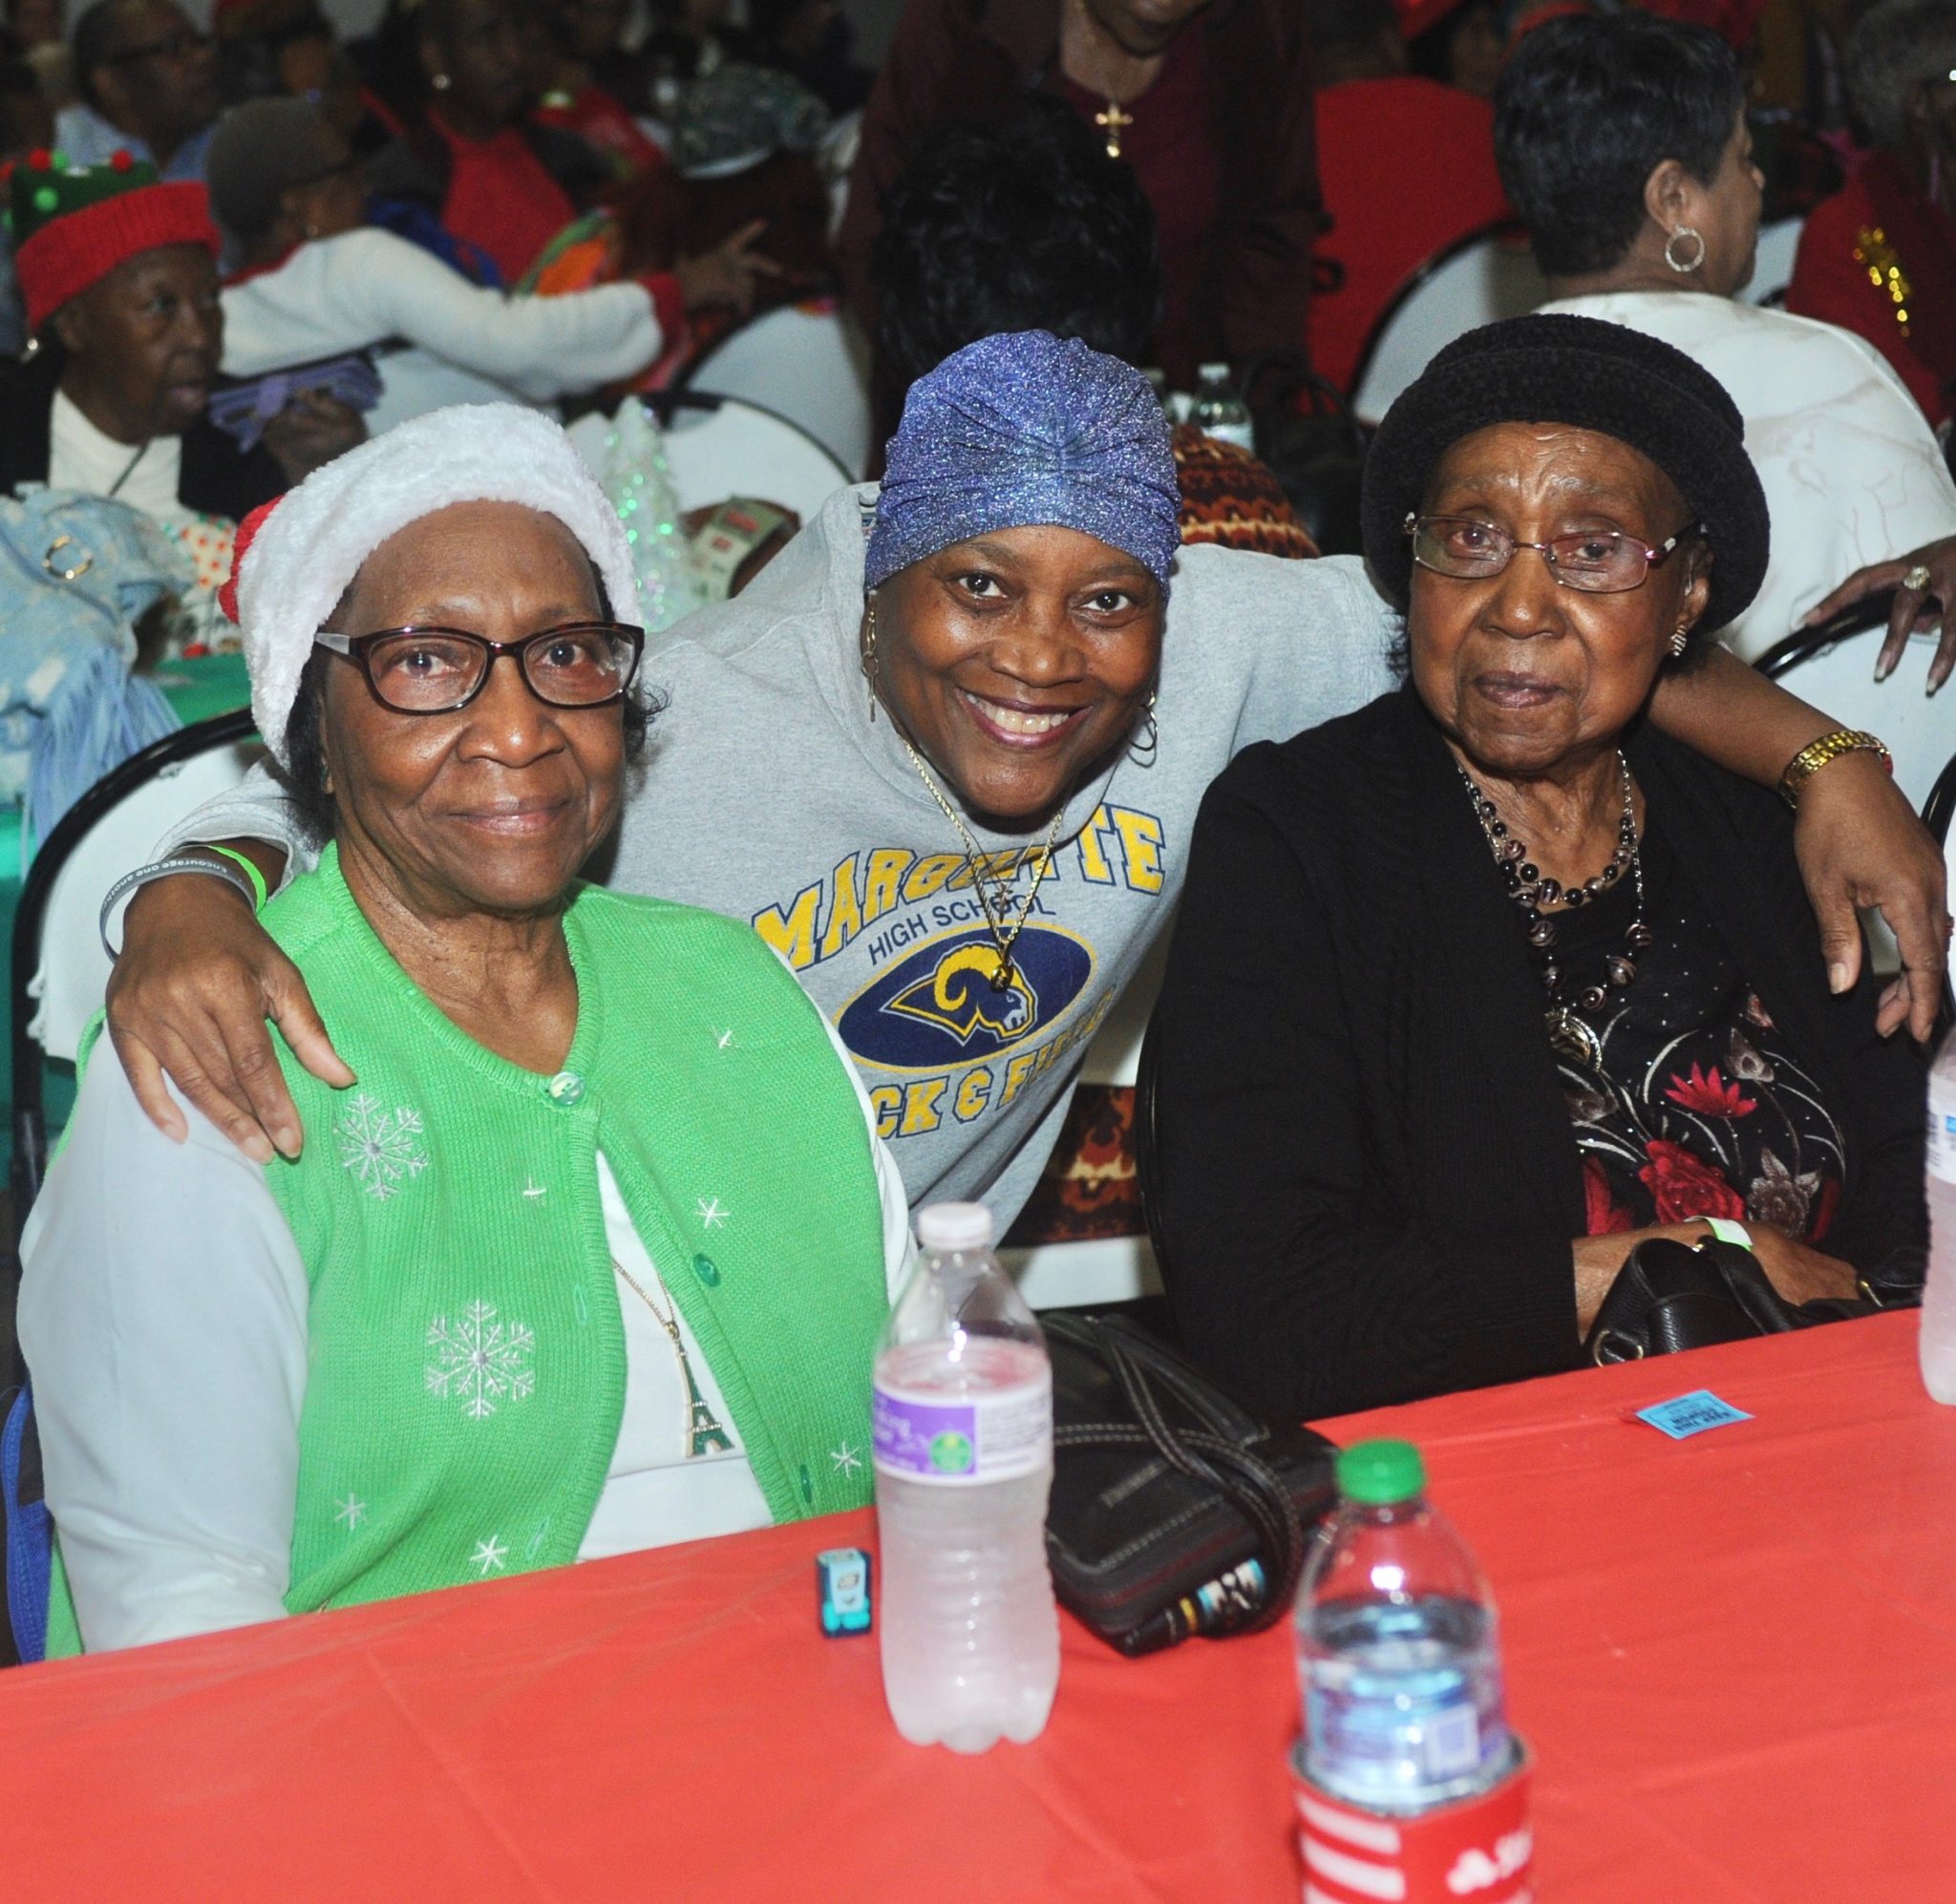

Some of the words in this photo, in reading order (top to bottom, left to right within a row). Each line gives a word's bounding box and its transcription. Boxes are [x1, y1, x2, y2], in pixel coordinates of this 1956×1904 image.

[136, 865, 160, 877] one
[161, 859, 227, 874] Encourage
[867, 913, 929, 965] HIGH
[931, 894, 1056, 927] SCHOOL
[952, 1064, 994, 1124] &
